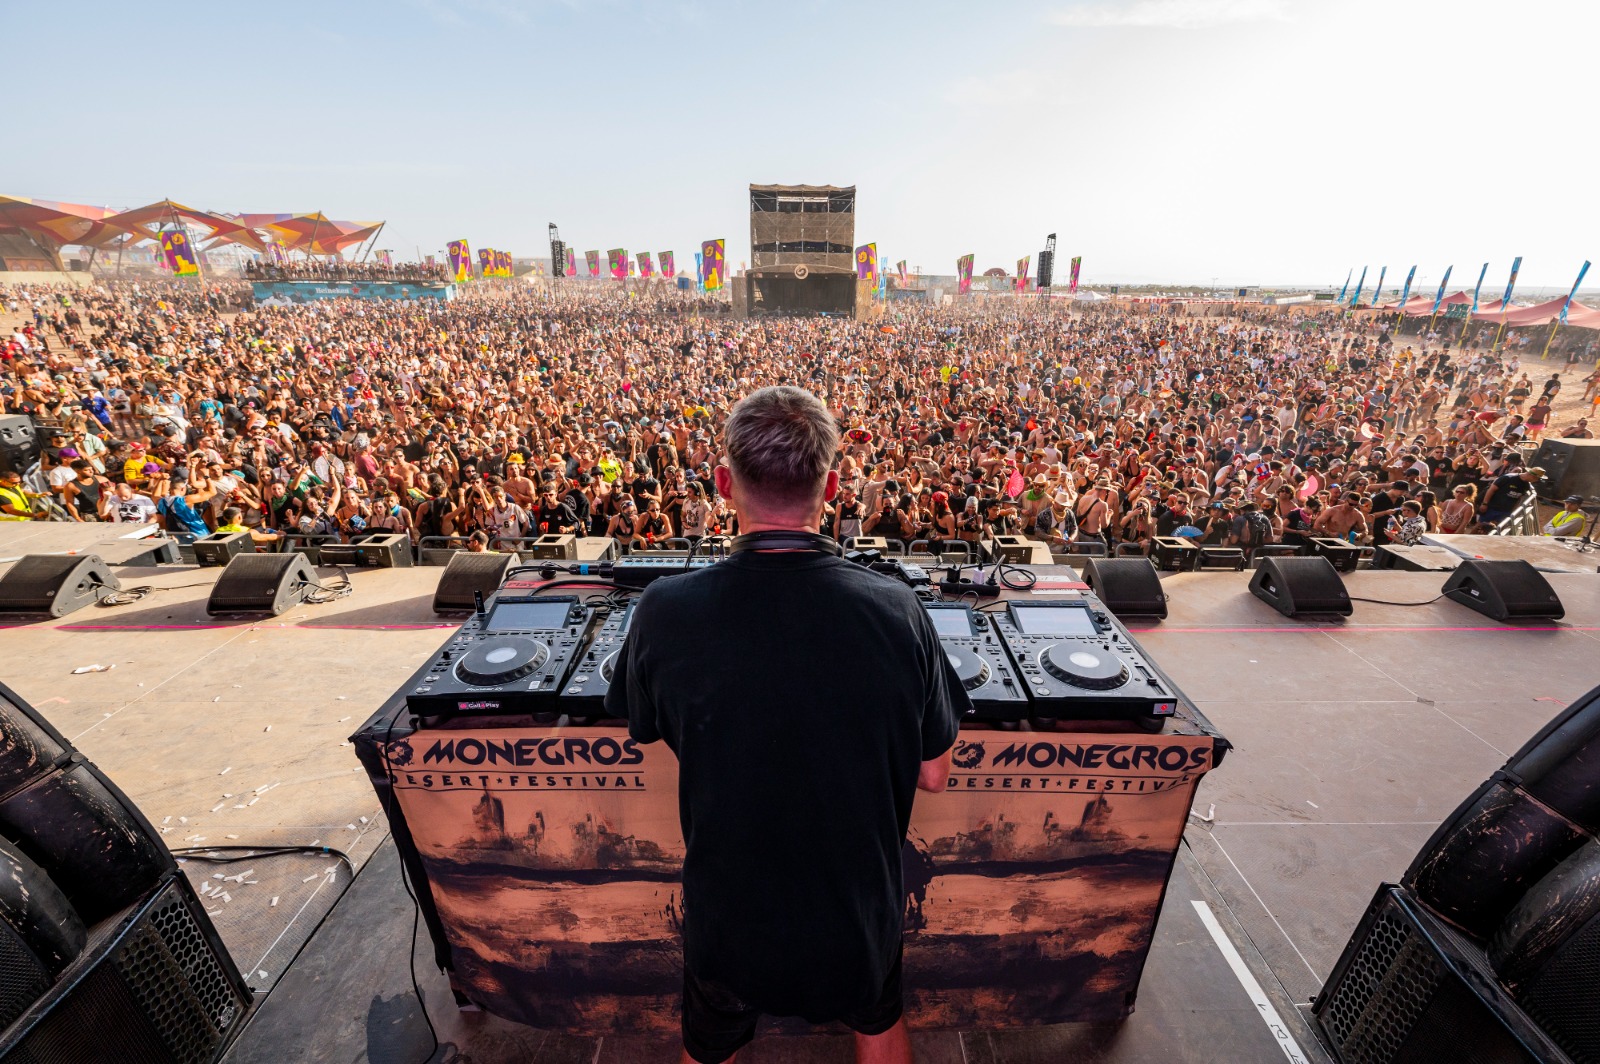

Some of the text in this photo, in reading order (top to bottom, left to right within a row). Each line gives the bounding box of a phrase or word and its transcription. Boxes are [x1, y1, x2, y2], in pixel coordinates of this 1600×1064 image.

[504, 520, 510, 528] 6
[422, 737, 644, 766] MONEGROS
[992, 742, 1211, 772] MONEGROS
[509, 775, 645, 788] FESTIVAL
[947, 777, 1050, 789] DESERT
